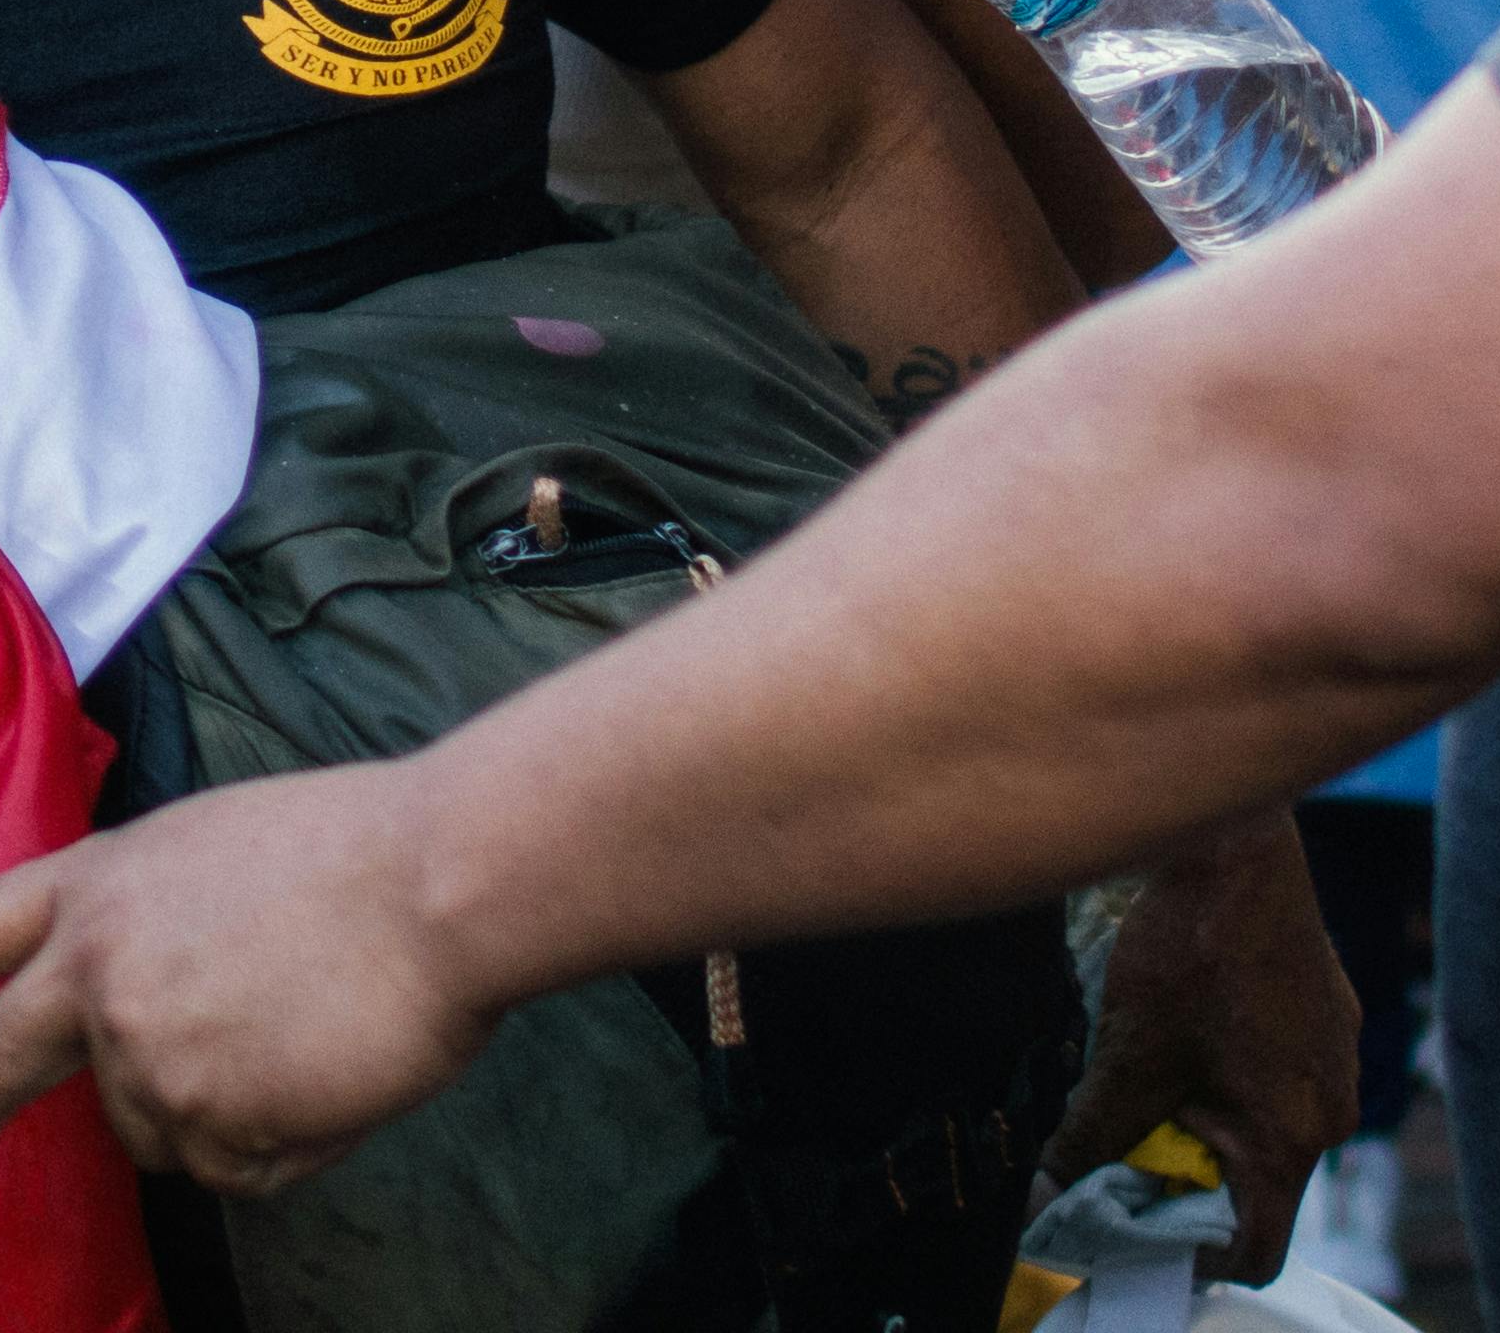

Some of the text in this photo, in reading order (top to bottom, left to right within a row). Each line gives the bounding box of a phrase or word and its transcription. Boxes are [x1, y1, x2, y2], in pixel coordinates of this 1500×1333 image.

[281, 27, 497, 87] SER Y NO PARECER
